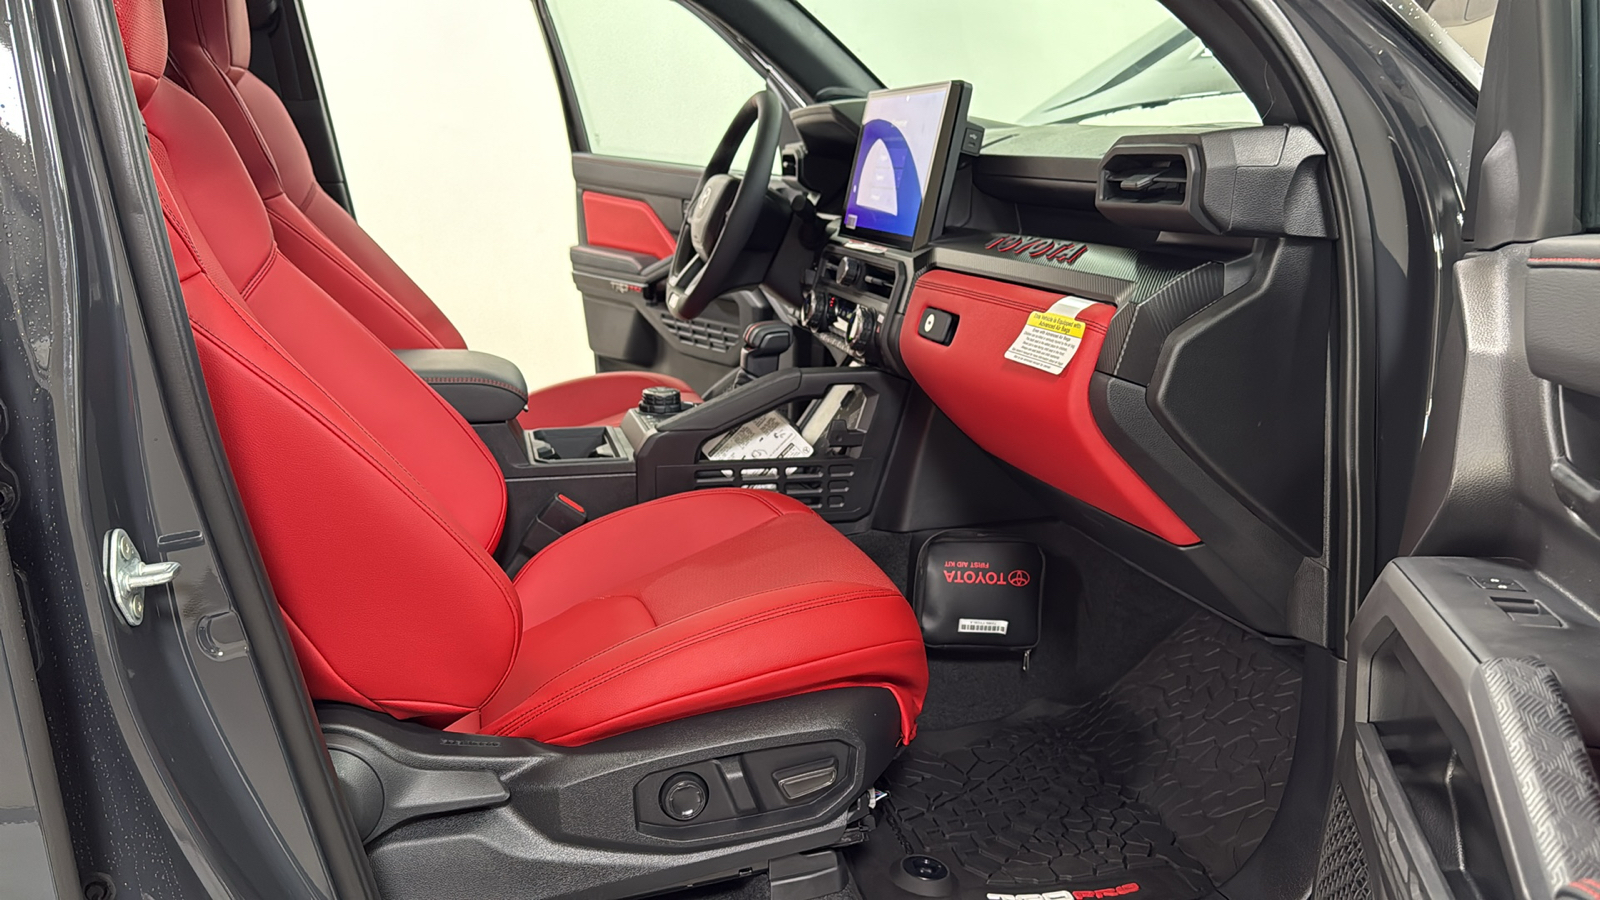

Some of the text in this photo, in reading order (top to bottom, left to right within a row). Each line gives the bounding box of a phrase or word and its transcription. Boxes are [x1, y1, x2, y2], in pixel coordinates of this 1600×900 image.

[985, 235, 1088, 263] TOYOTA
[1039, 320, 1056, 329] Advanced
[1061, 325, 1071, 334] Bags
[1041, 314, 1053, 322] Vehicle
[1057, 317, 1074, 327] Equipped
[944, 560, 956, 568] KIT
[970, 561, 990, 569] FIRST
[943, 570, 1007, 585] TOYOTA
